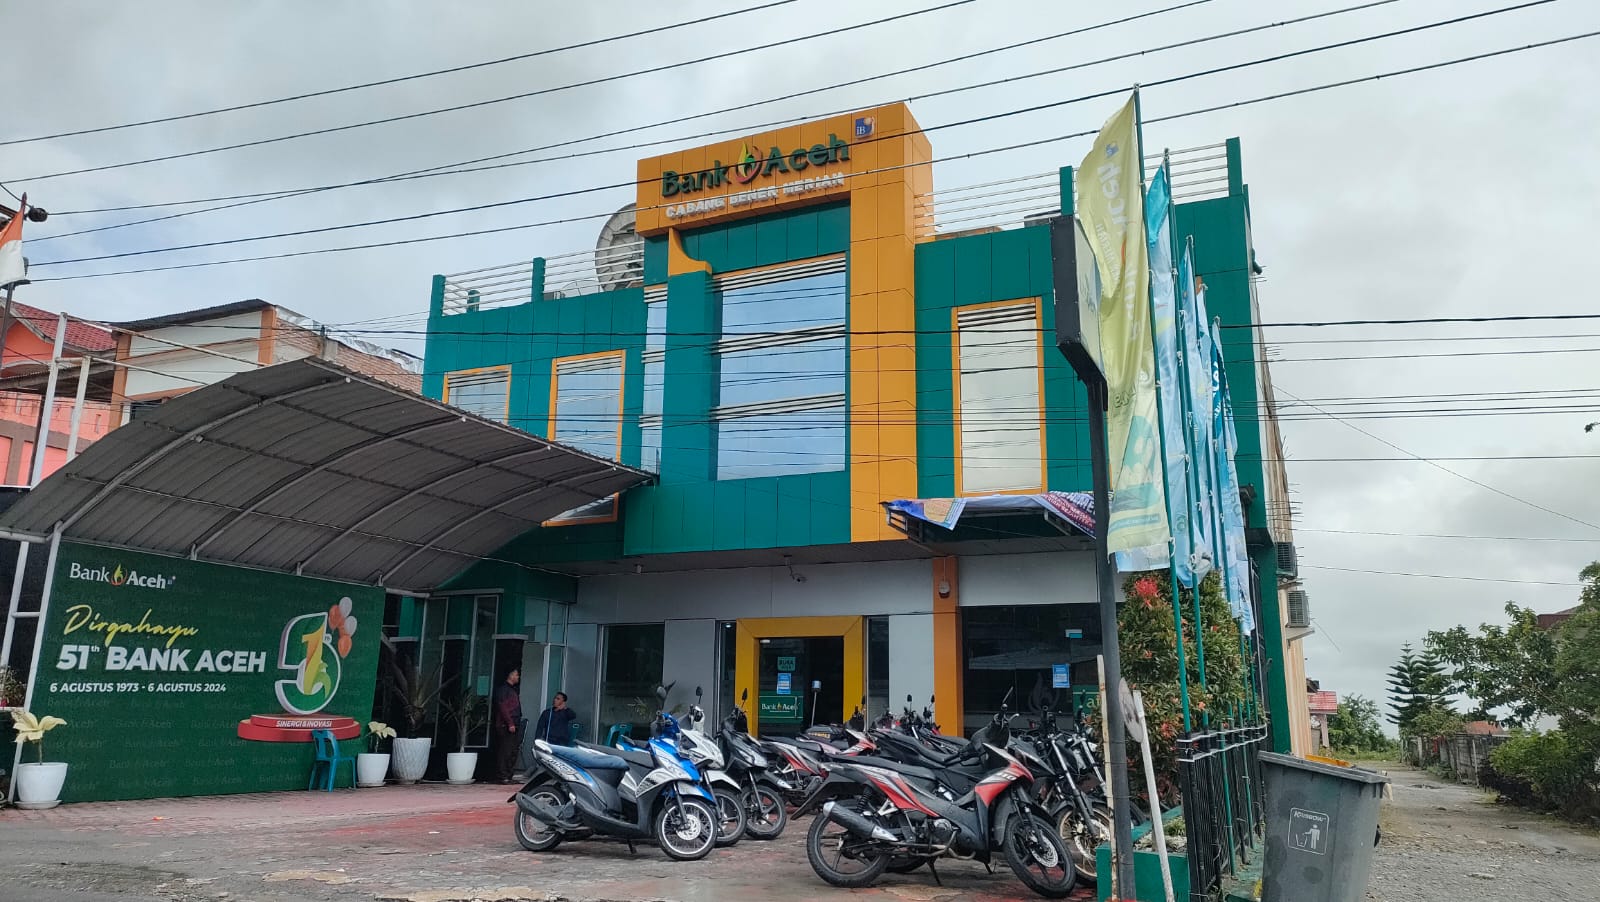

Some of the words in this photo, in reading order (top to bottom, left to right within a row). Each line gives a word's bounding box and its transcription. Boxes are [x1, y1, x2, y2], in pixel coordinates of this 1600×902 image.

[661, 159, 731, 197] Bank
[762, 134, 851, 176] Aceh
[666, 197, 725, 218] CABANG
[730, 186, 778, 205] BENER
[783, 172, 845, 195] MERIAH
[69, 562, 110, 583] Bank
[126, 571, 166, 589] Aceh
[63, 604, 199, 649] Dirgahayu
[105, 646, 191, 671] BANK
[194, 649, 267, 673] ACEH
[50, 683, 58, 693] 6
[60, 683, 114, 693] AGUSTUS
[117, 683, 140, 692] 1973
[148, 683, 155, 692] 6
[156, 683, 202, 692] AGUSTUS
[203, 683, 227, 692] 2024
